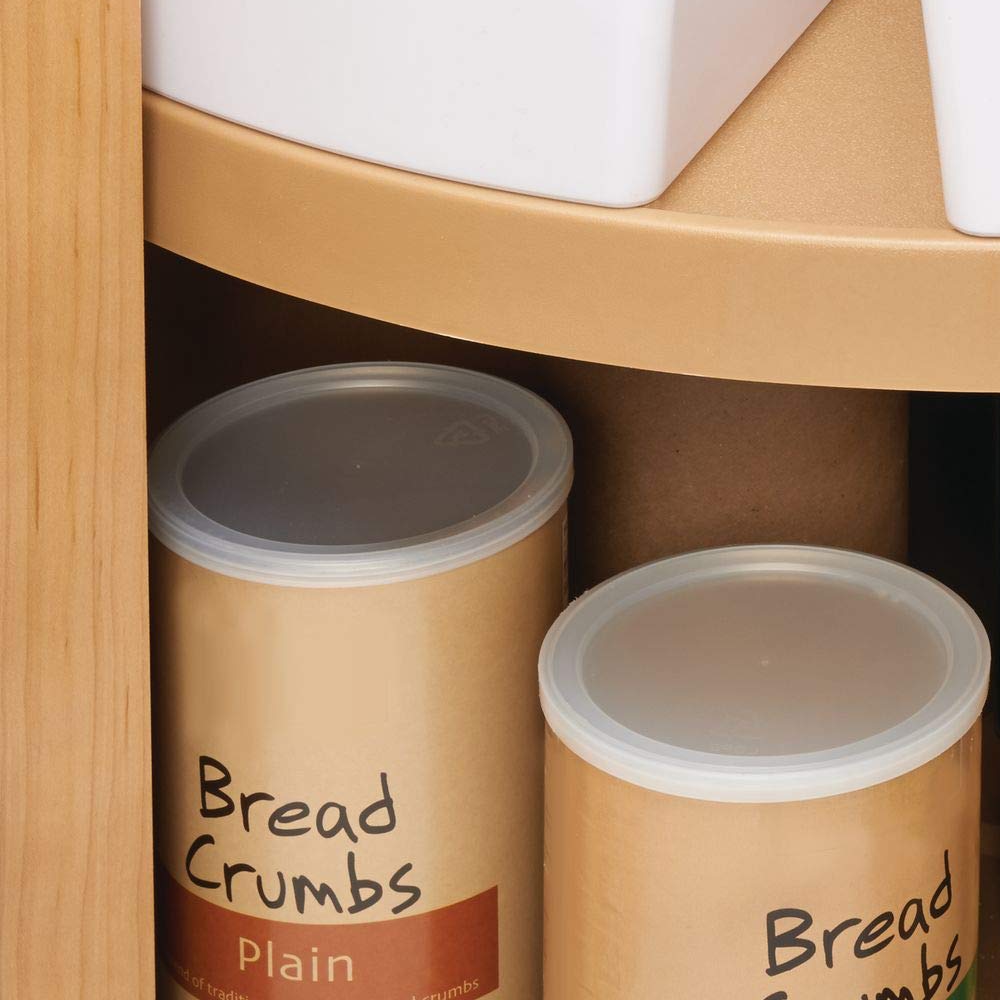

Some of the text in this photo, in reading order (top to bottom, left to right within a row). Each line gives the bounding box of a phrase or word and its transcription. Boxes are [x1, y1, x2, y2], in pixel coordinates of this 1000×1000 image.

[199, 755, 397, 843] Bread
[186, 834, 421, 914] Crumbs
[765, 849, 952, 977] Bread
[191, 977, 205, 989] of
[239, 937, 354, 982] Plain
